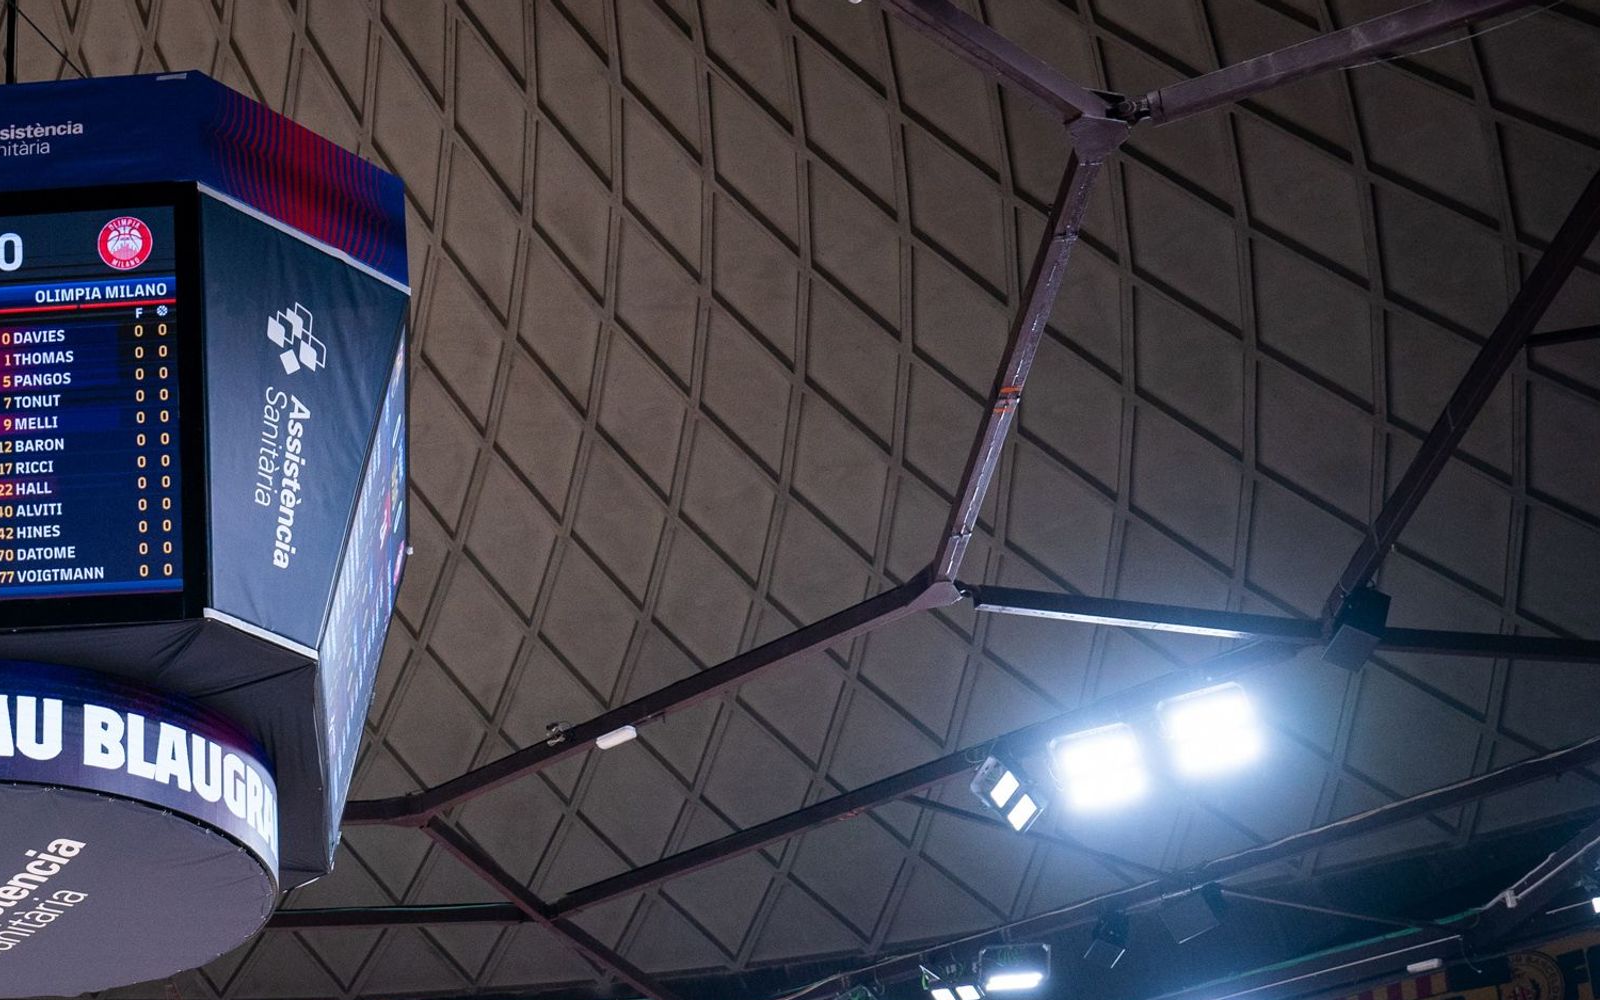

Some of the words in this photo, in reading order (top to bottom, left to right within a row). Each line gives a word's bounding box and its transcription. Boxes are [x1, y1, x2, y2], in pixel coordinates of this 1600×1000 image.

[35, 287, 101, 303] OLIMPIA
[106, 283, 166, 298] MILANO
[136, 308, 142, 318] F
[2, 333, 10, 344] 0
[14, 330, 65, 344] DAVIES
[135, 325, 142, 336] 0
[159, 324, 166, 335] 0
[6, 355, 10, 365] 1
[13, 351, 73, 365] THOMAS
[135, 347, 143, 358] 0
[4, 376, 10, 387] 5
[15, 373, 71, 386] PANGOS
[136, 369, 143, 380] 0
[4, 397, 11, 408] 7
[14, 395, 60, 408] TONUT
[136, 390, 144, 401] 0
[4, 419, 11, 430] 9
[15, 416, 57, 430] MELLI
[137, 412, 144, 423] 0
[0, 441, 12, 453] 12
[16, 438, 64, 452] BARON
[137, 434, 145, 445] 0
[254, 386, 287, 507] Sanitària
[0, 463, 12, 474] 17
[16, 461, 53, 474] RICCI
[138, 456, 145, 467] 0
[16, 482, 52, 495] HALL
[138, 477, 146, 488] 0
[272, 395, 311, 570] Assistència
[16, 503, 62, 517] ALVITI
[139, 499, 147, 510] 0
[17, 525, 60, 538] HINES
[139, 521, 147, 532] 0
[17, 546, 75, 560] DATOME
[139, 543, 147, 554] 0
[0, 571, 14, 583] 77
[17, 567, 104, 582] VOIGTMANN
[140, 565, 148, 576] 0
